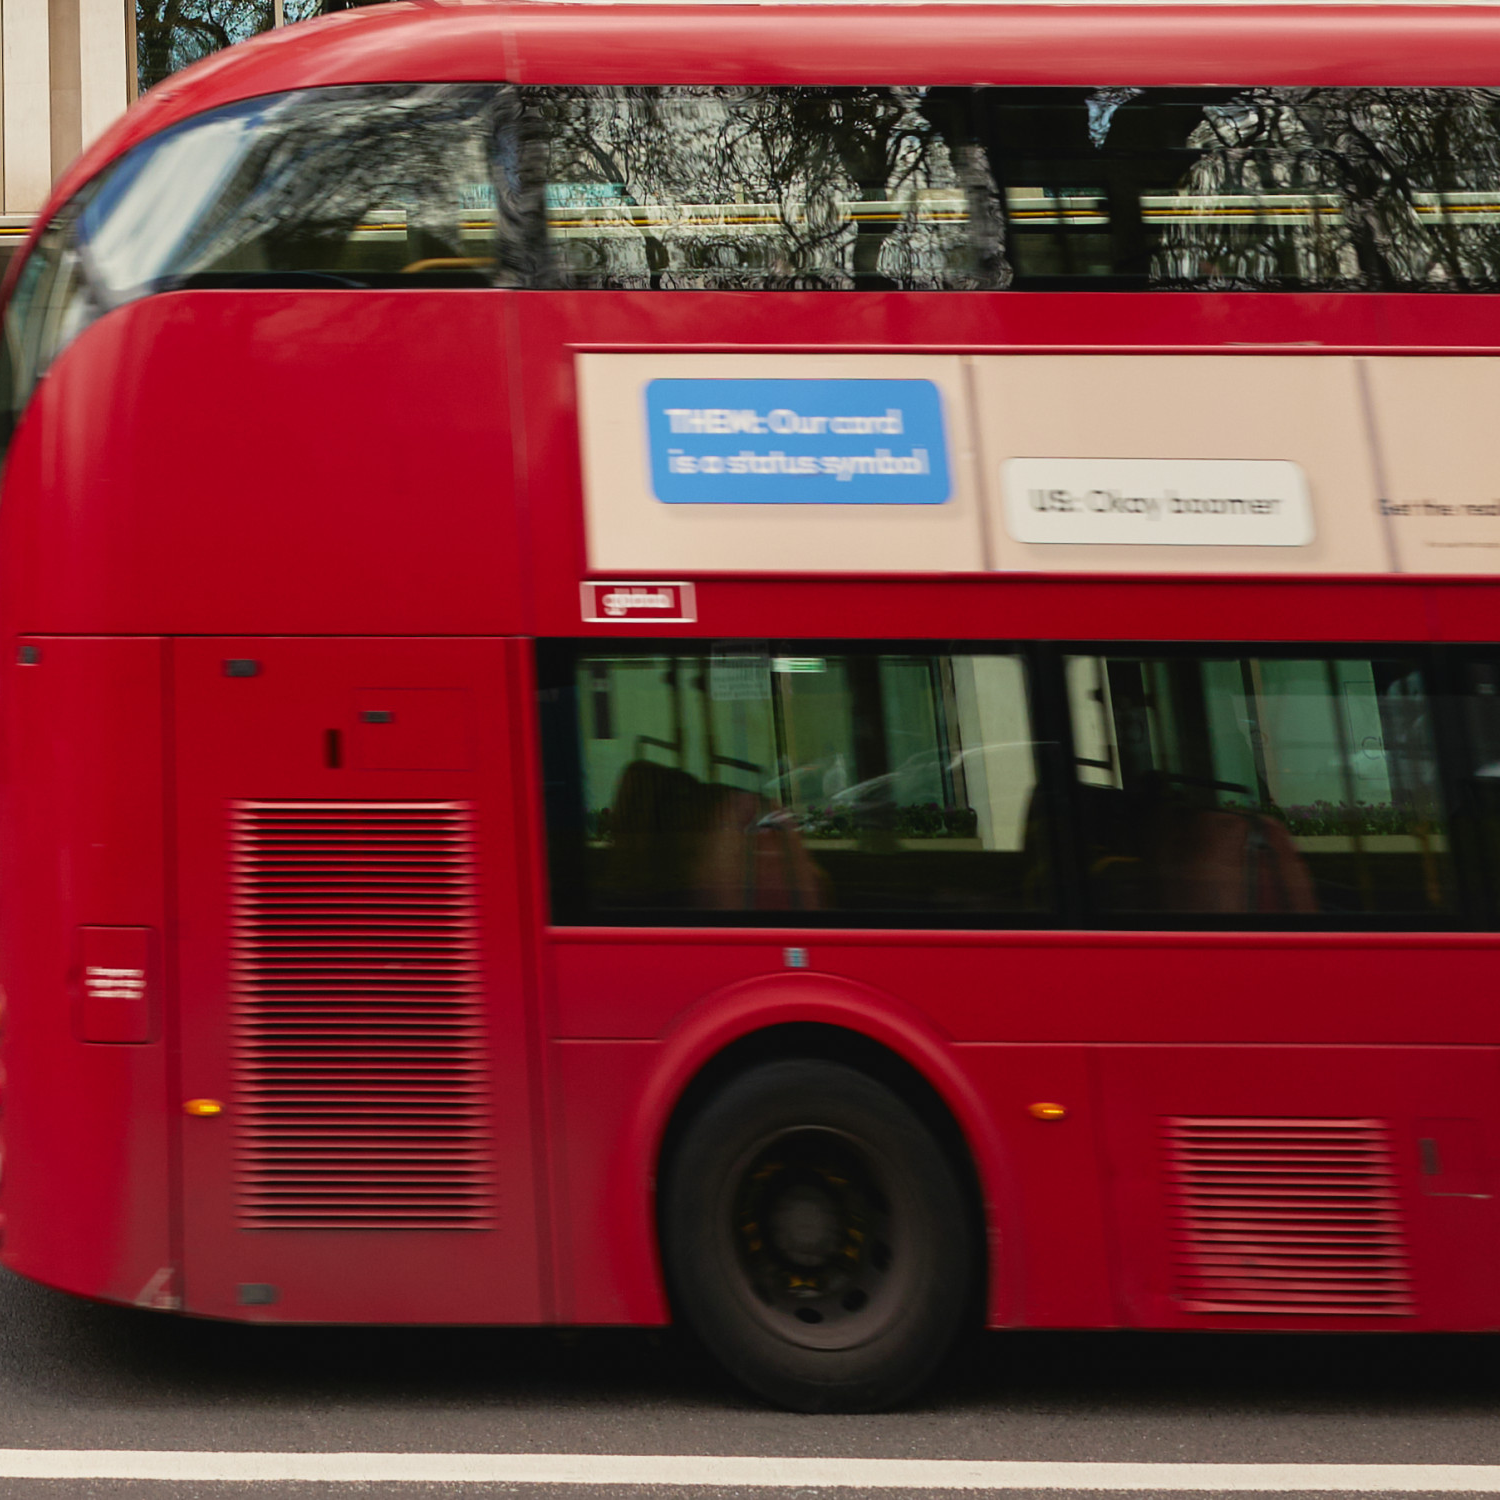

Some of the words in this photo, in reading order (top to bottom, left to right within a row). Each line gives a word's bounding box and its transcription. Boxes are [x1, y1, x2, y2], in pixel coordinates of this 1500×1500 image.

[663, 408, 768, 434] THEM:
[767, 408, 828, 434] Our
[828, 408, 904, 435] card
[667, 448, 700, 474] is
[725, 450, 822, 474] status
[818, 448, 930, 482] symbol
[1085, 489, 1161, 521] Okay
[1163, 489, 1282, 514] boomer
